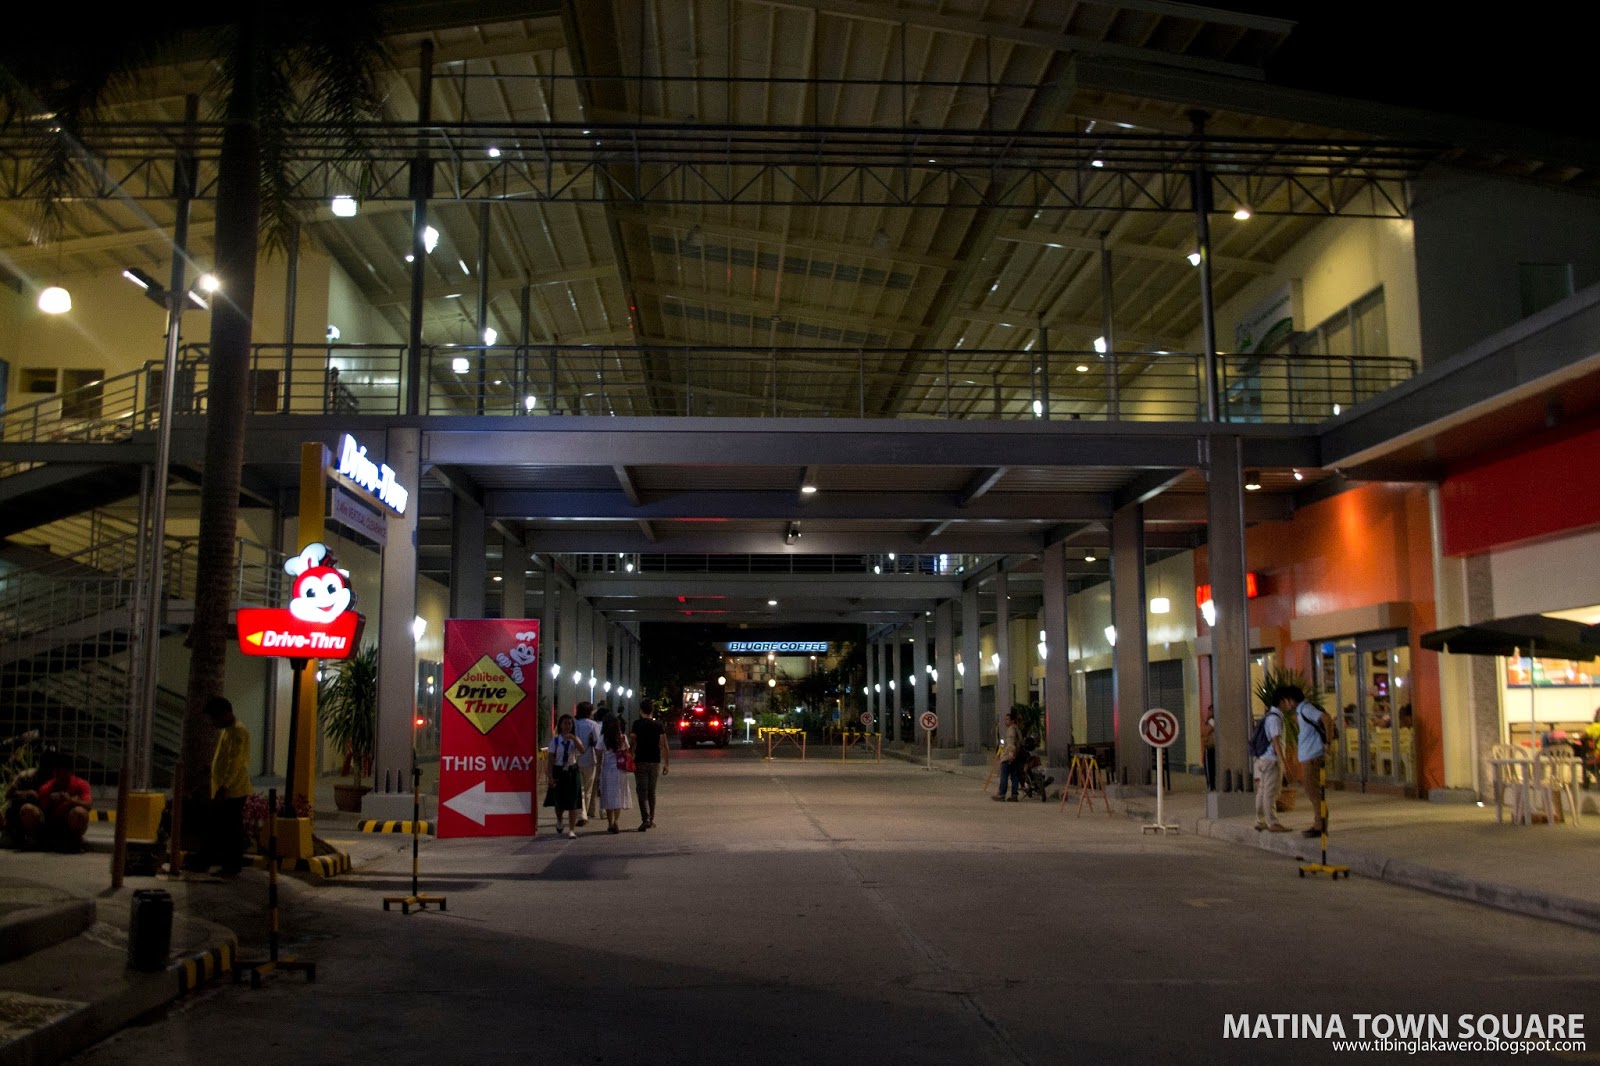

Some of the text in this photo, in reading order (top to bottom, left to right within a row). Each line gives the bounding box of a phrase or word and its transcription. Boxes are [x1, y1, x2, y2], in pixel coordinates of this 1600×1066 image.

[340, 433, 408, 514] Drive-Thru
[262, 630, 347, 649] Drive-Thru
[780, 642, 827, 651] COFFEE
[463, 672, 505, 682] Jollibee
[455, 684, 507, 699] Drive
[464, 699, 509, 714] Thru
[442, 756, 534, 771] THIS WAY
